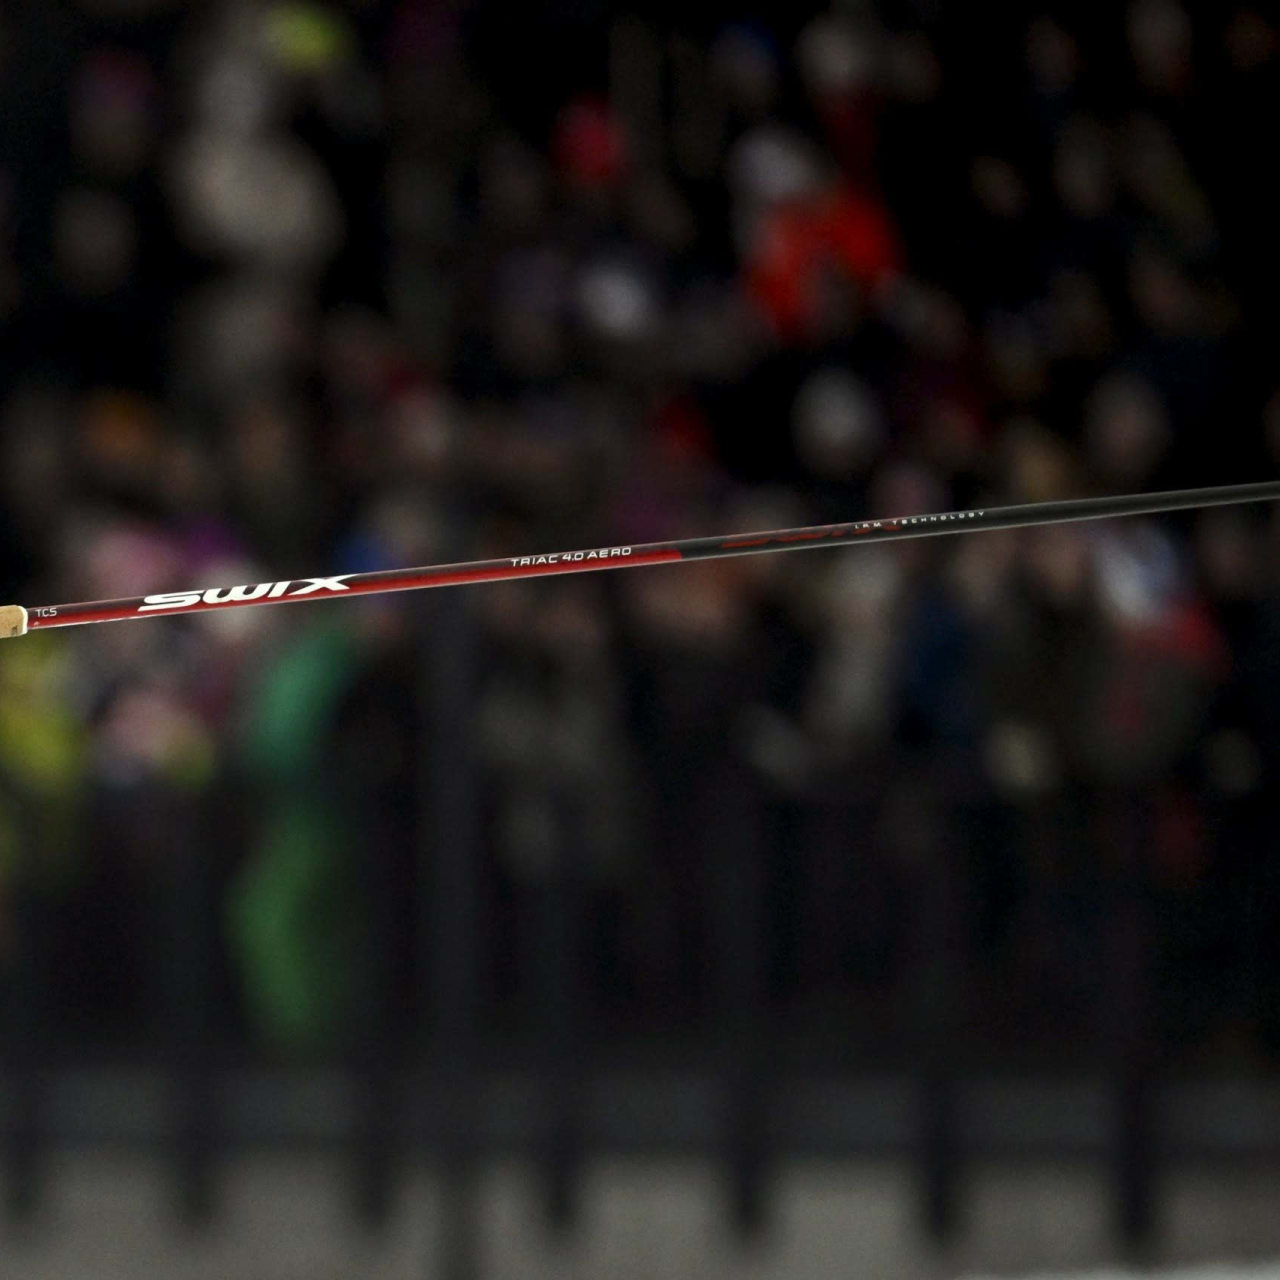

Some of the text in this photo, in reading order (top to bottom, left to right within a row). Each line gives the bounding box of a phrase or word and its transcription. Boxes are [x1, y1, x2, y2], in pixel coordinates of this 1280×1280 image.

[892, 511, 984, 525] TECHNOLOGY
[511, 547, 631, 567] TRIAC 4.0 AERO
[138, 573, 358, 612] SWIX
[35, 607, 57, 617] TCS
